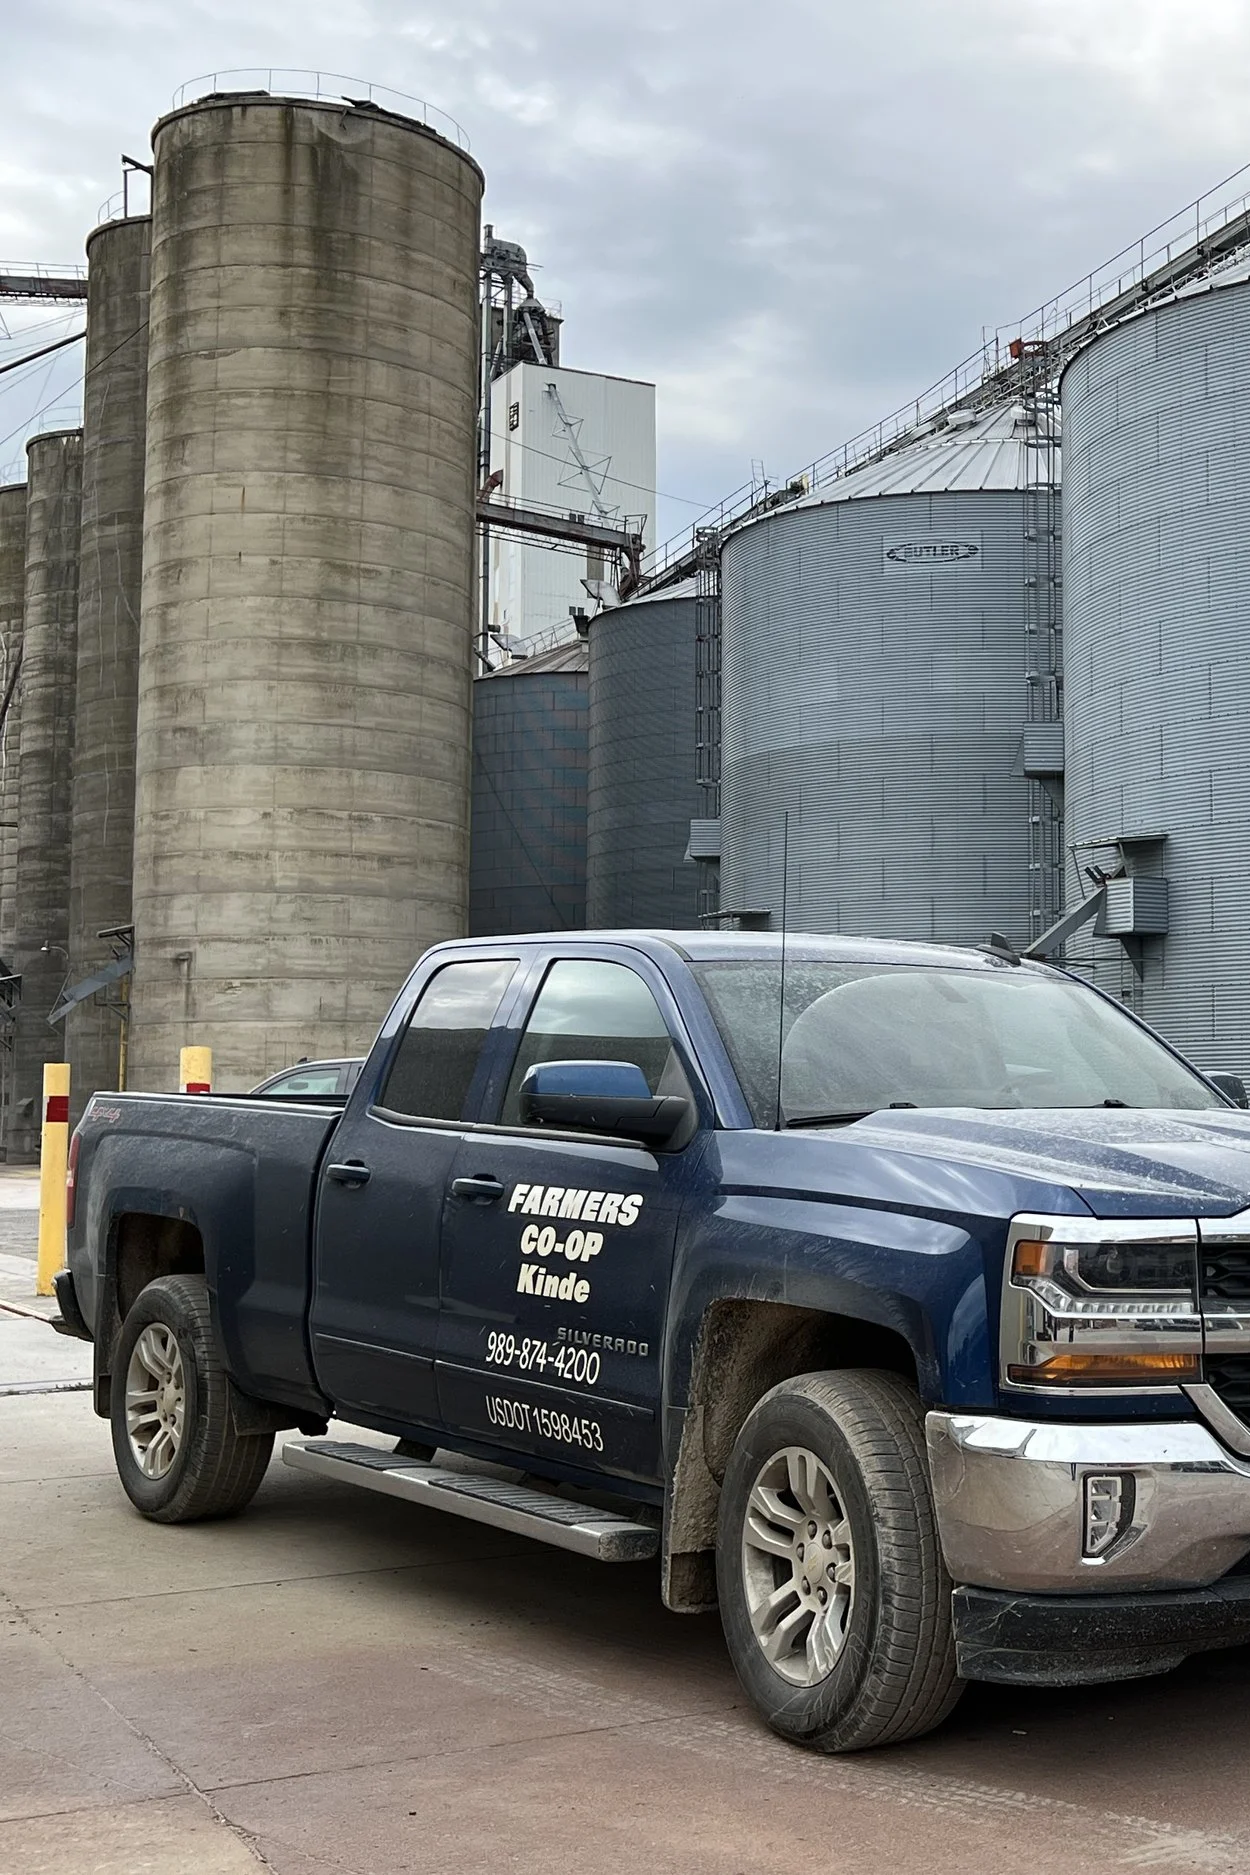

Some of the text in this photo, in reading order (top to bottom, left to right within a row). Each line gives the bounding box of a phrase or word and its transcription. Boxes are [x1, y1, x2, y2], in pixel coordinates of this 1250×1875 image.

[507, 1183, 644, 1226] FARMERS
[520, 1224, 604, 1262] CO-OP
[516, 1263, 590, 1303] Kinde
[485, 1331, 601, 1385] 989-874-4200
[557, 1327, 649, 1356] SILVERADO
[485, 1395, 604, 1451] USDOT 1598453
